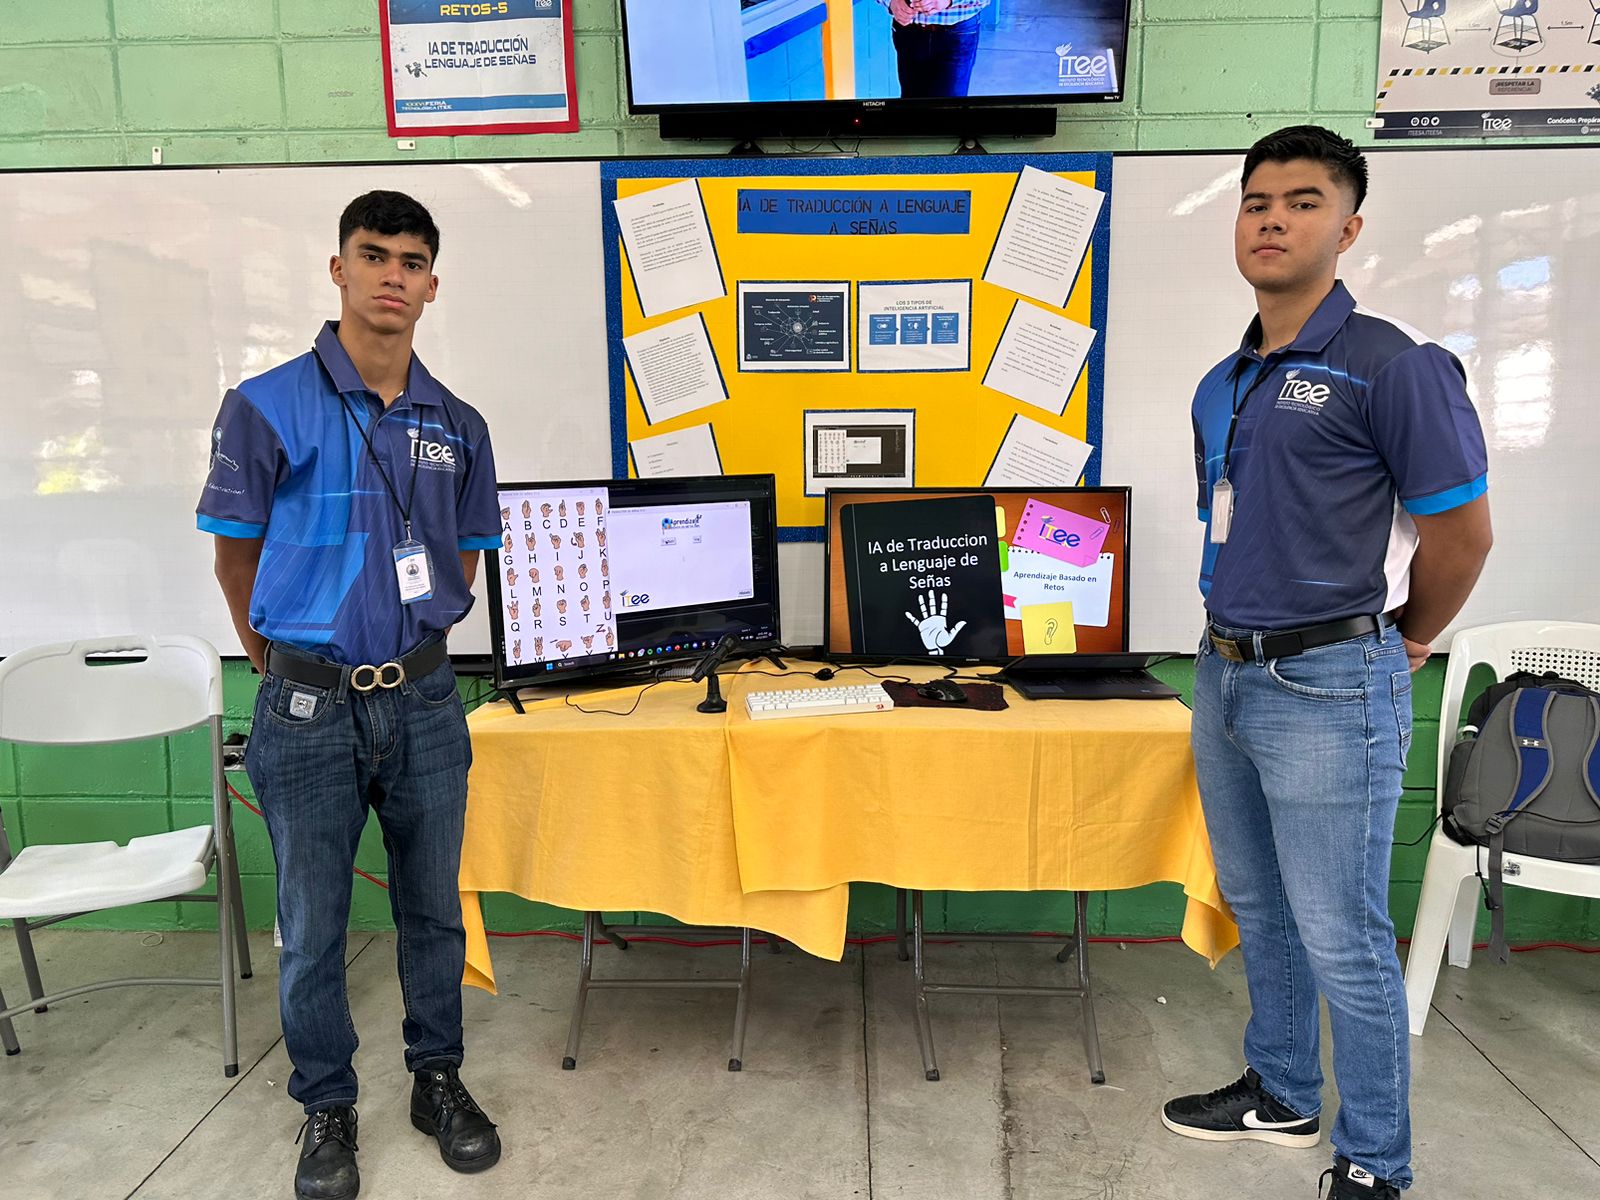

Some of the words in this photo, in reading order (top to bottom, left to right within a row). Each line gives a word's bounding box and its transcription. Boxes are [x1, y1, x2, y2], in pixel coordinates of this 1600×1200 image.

[440, 2, 508, 16] RETOS-5
[428, 41, 440, 55] IA
[441, 41, 456, 55] DE
[458, 34, 529, 55] TRADUCCIÓN
[424, 57, 482, 69] LENGUAJE
[483, 56, 498, 67] DE
[499, 53, 537, 66] SEÑAS
[738, 199, 751, 212] IA
[760, 199, 778, 213] DE
[787, 197, 872, 213] TRADUCCIÓN
[880, 200, 889, 213] A
[897, 199, 966, 213] LENGUAJE
[829, 222, 838, 235] A
[849, 218, 898, 235] SEÑAS
[503, 522, 512, 532] A
[524, 520, 532, 530] B
[542, 520, 551, 529] C
[560, 519, 568, 528] D
[578, 518, 585, 527] E
[597, 516, 604, 526] F
[868, 541, 883, 555] IA
[886, 539, 904, 553] de
[907, 534, 988, 551] Traduccion
[504, 555, 513, 565] G
[528, 553, 537, 563] H
[555, 551, 560, 561] I
[578, 550, 584, 560] J
[599, 548, 607, 558] K
[880, 561, 888, 572] a
[892, 554, 956, 573] Lenguaje
[960, 552, 979, 566] de
[909, 574, 951, 589] Señas
[1013, 571, 1057, 581] Aprendizaje
[1059, 573, 1086, 582] Basado
[510, 589, 518, 599] L
[532, 586, 542, 596] M
[557, 584, 565, 594] N
[579, 582, 589, 592] O
[603, 580, 610, 590] P
[1043, 583, 1065, 591] Retos
[510, 622, 520, 632] Q
[534, 620, 543, 630] R
[559, 616, 567, 626] S
[583, 613, 591, 623] T
[604, 611, 612, 621] U
